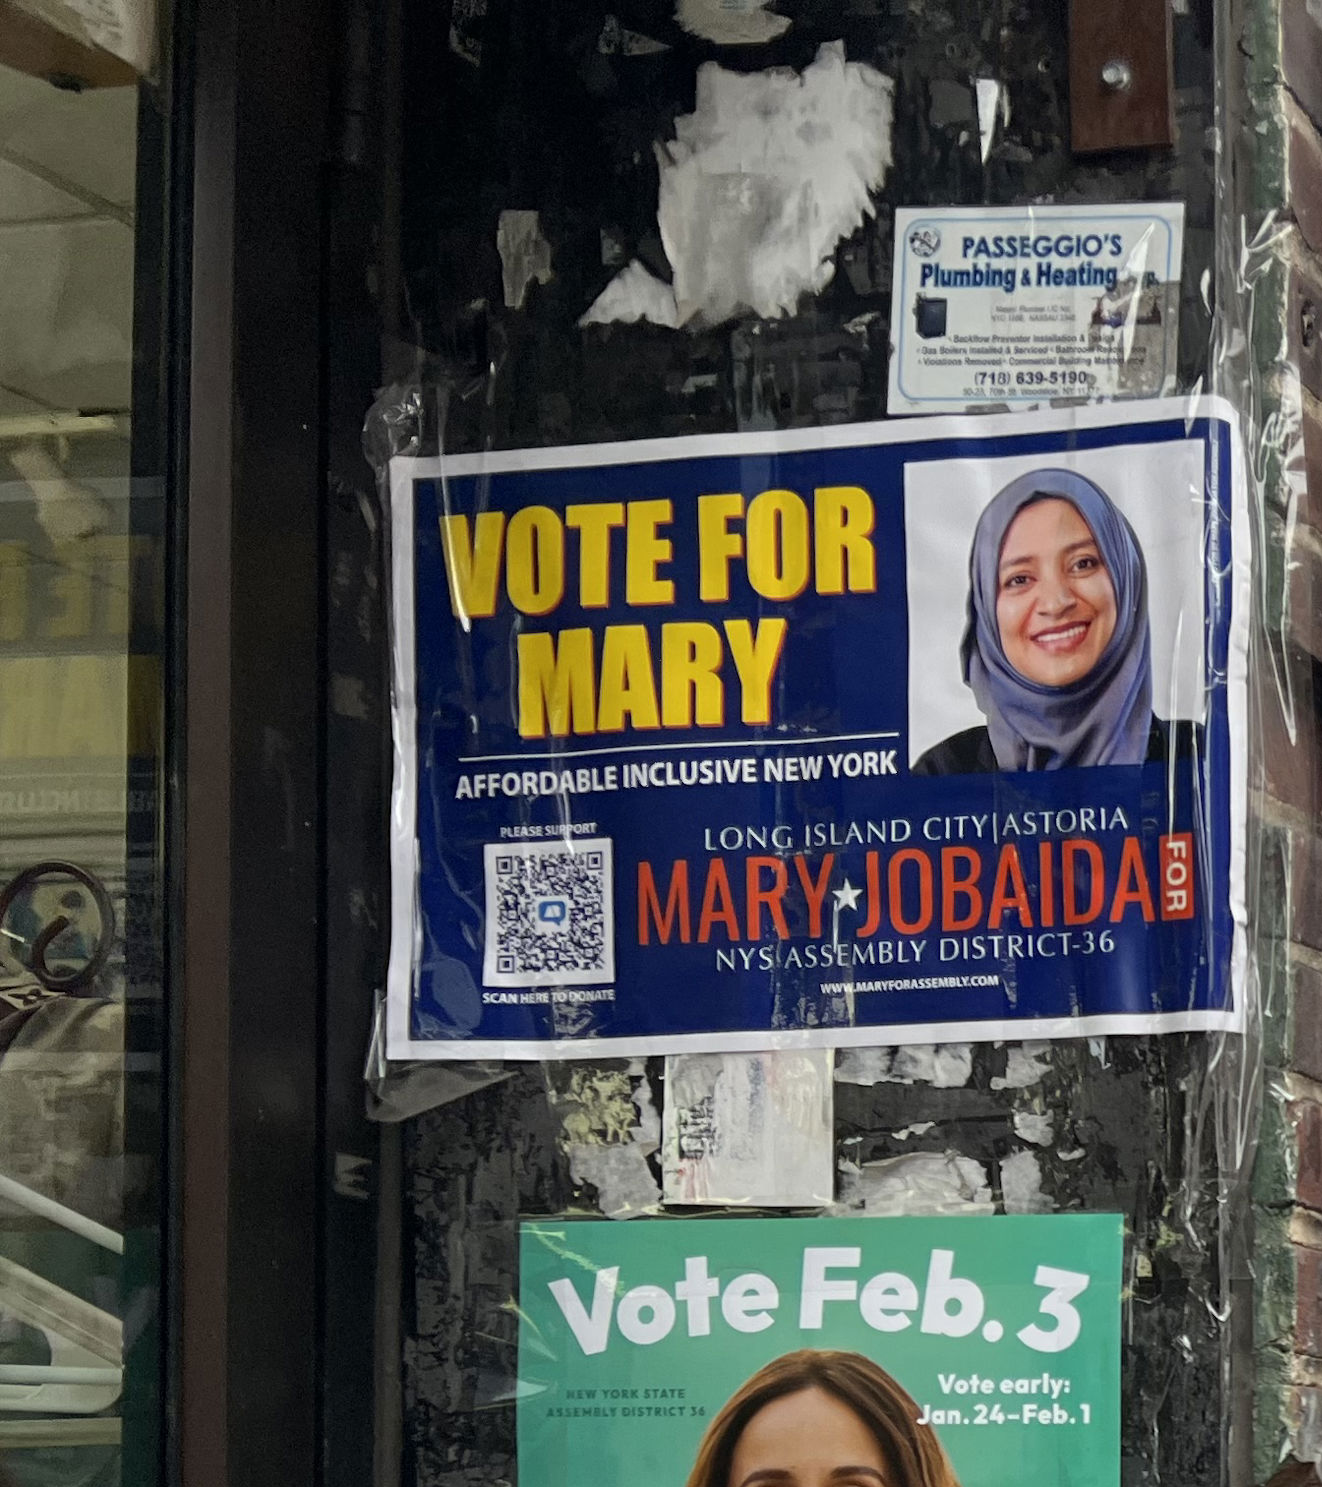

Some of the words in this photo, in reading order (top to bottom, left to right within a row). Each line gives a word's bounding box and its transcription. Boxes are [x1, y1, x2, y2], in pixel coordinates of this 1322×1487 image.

[961, 233, 1123, 258] PASSEGGIO'S
[920, 263, 1016, 294] Plumbing
[1021, 268, 1032, 286] &
[1036, 262, 1118, 293] Heating
[974, 371, 1011, 387] (718)
[1015, 370, 1088, 386] 639-5190
[440, 497, 675, 618] VOTE
[697, 485, 877, 603] FOR
[517, 617, 789, 740] MARY
[455, 764, 618, 800] AFFORDABLE
[623, 757, 758, 789] INCLUSIVE
[763, 753, 823, 782] NEW
[827, 750, 899, 778] YORK
[500, 823, 544, 838] PLEASE
[545, 821, 598, 837] SUPPORT
[704, 823, 794, 852] LONG
[804, 817, 912, 848] ISLAND
[637, 852, 835, 946] MARY
[856, 835, 1156, 939] JOBAIDA
[1165, 840, 1188, 913] FOR
[716, 946, 774, 972] NYS
[785, 939, 926, 969] ASSEMBLY
[939, 929, 1115, 962] DISTRICT-36
[482, 991, 518, 1005] SCAN
[520, 990, 549, 1004] HERE
[551, 989, 566, 1003] TO
[568, 988, 616, 1002] DONATE
[820, 974, 999, 995] WWW.MARYFORASSEMBLY.COM
[547, 1254, 780, 1357] Vote
[798, 1246, 1004, 1344] Feb.
[1016, 1263, 1090, 1353] 3
[566, 1387, 598, 1400] NEW
[600, 1387, 639, 1400] YORK
[643, 1387, 686, 1400] STATE
[937, 1373, 995, 1395] Vote
[999, 1372, 1071, 1400] early:
[546, 1406, 617, 1418] ASSEMBLY
[620, 1405, 686, 1418] DISTRICT
[689, 1405, 706, 1418] 36
[916, 1403, 970, 1426] Jan.
[1080, 1403, 1092, 1425] 1
